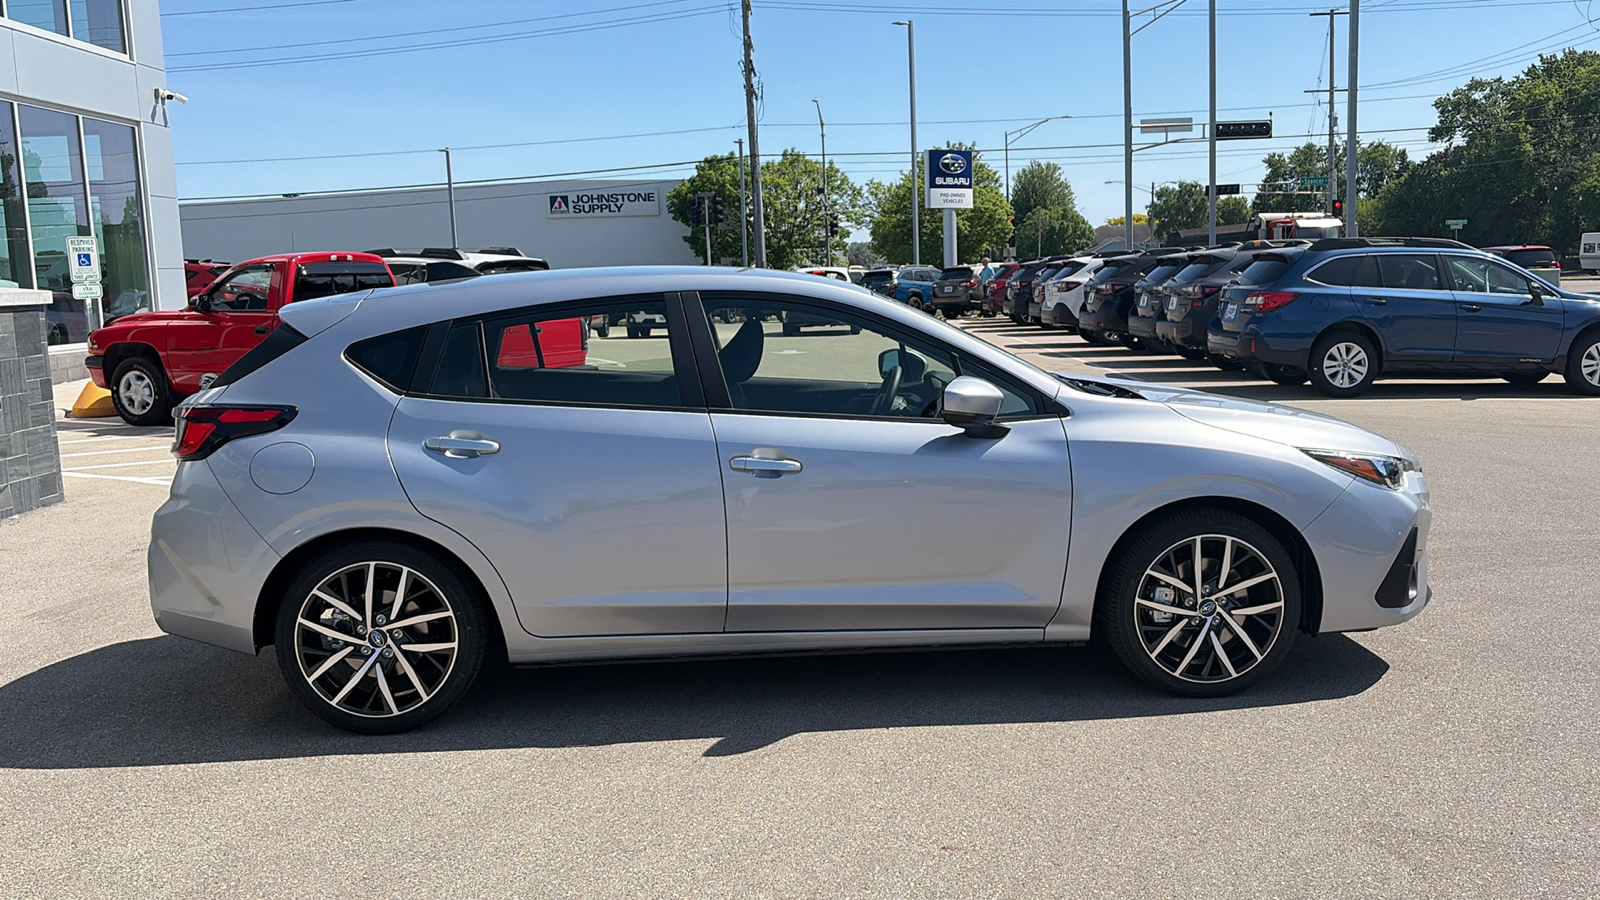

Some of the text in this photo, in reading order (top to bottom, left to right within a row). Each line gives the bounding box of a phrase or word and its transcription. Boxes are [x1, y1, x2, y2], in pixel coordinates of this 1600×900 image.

[935, 177, 970, 185] SUBARU
[572, 193, 655, 204] JOHNSTONE
[573, 203, 624, 214] SUPPLY
